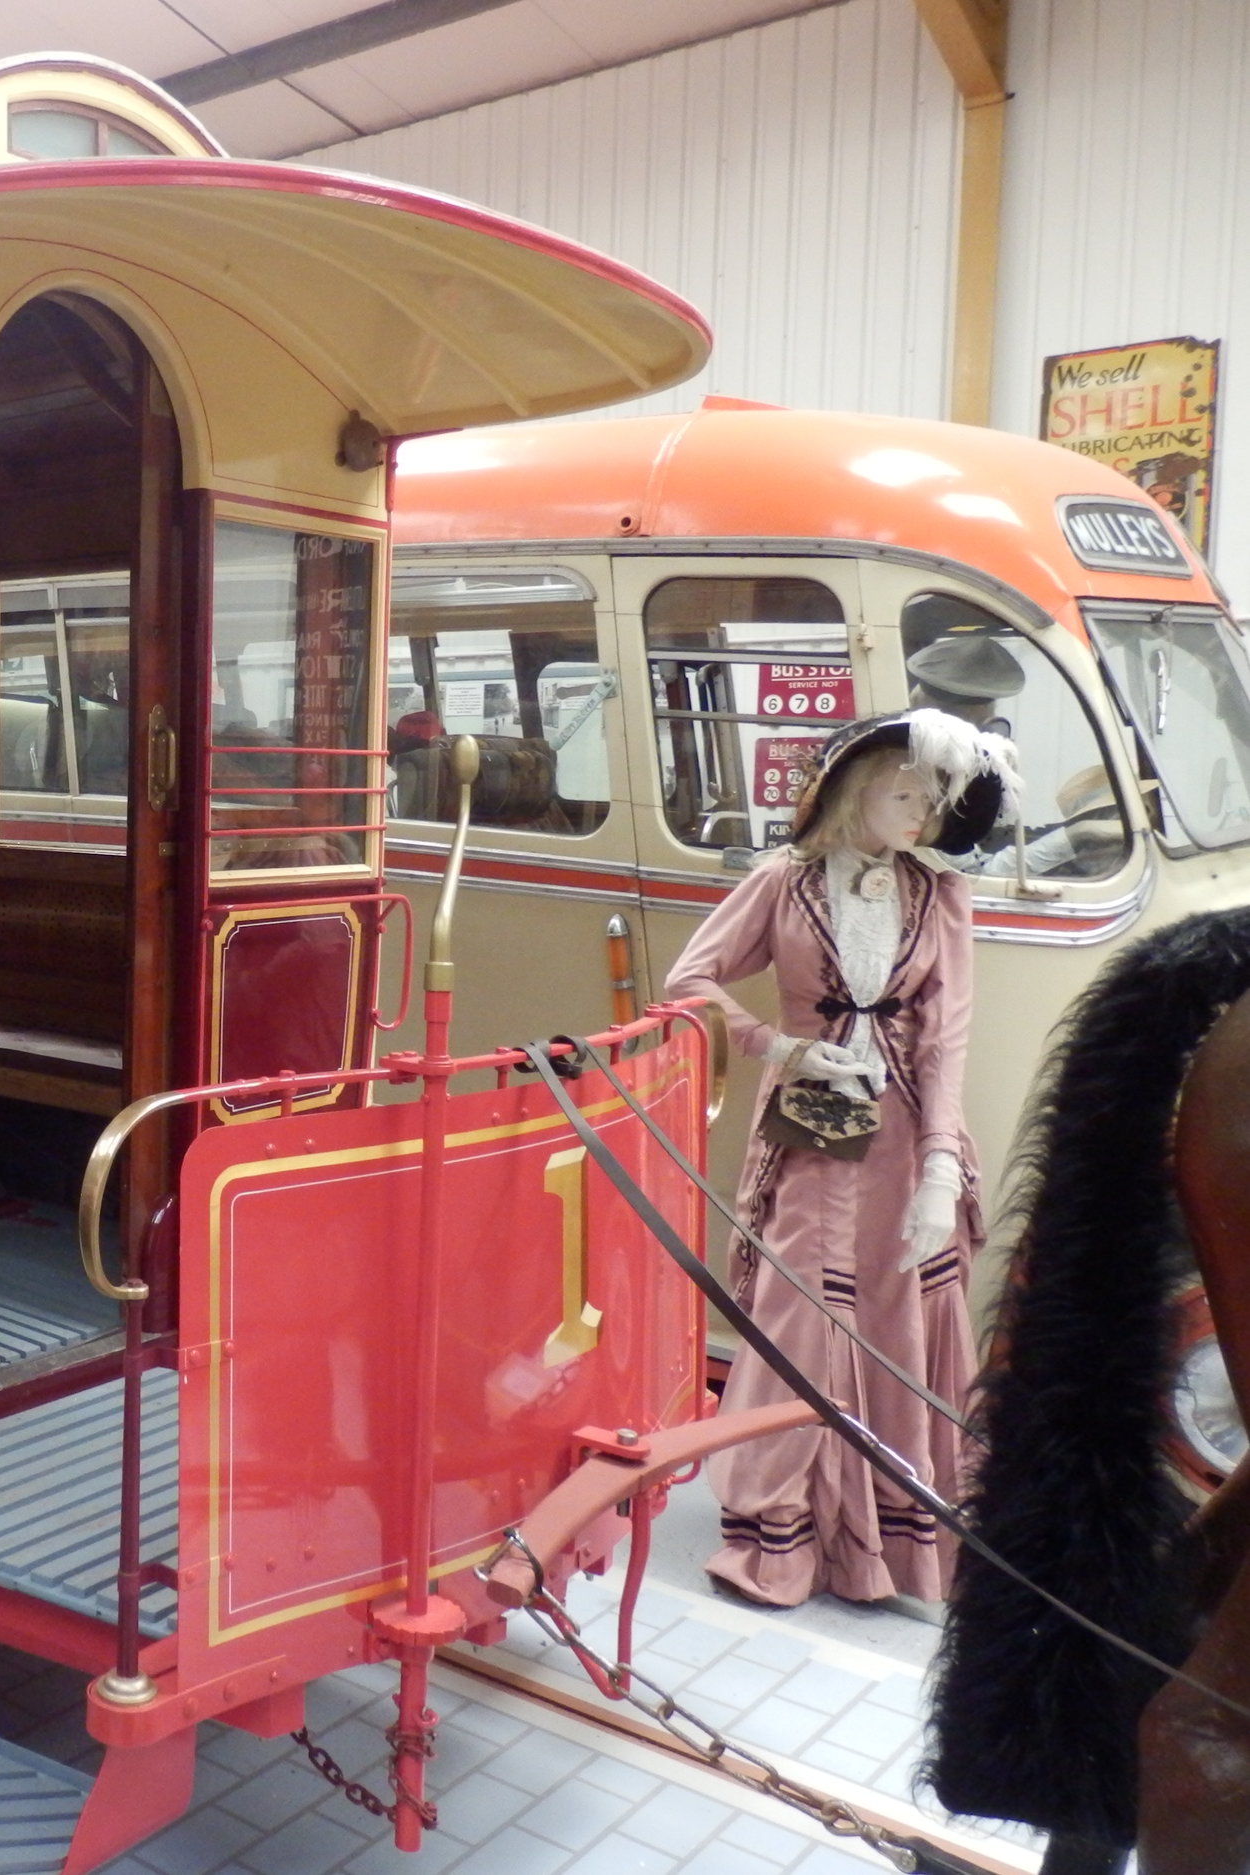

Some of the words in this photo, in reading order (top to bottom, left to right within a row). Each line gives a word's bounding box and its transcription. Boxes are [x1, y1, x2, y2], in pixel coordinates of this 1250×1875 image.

[1056, 361, 1093, 391] We
[1095, 353, 1146, 387] sell
[1049, 380, 1202, 439] SHELL
[1061, 427, 1203, 457] BRICATING
[1068, 512, 1177, 559] MULLEYS
[771, 664, 804, 678] BUS
[788, 681, 818, 689] SERVICE
[768, 698, 778, 710] 6
[795, 698, 805, 710] 7
[820, 697, 830, 710] 8
[769, 744, 799, 757] BUS
[769, 771, 776, 782] 2
[789, 771, 801, 782] 72
[765, 789, 778, 799] 70
[543, 1145, 603, 1369] 1
